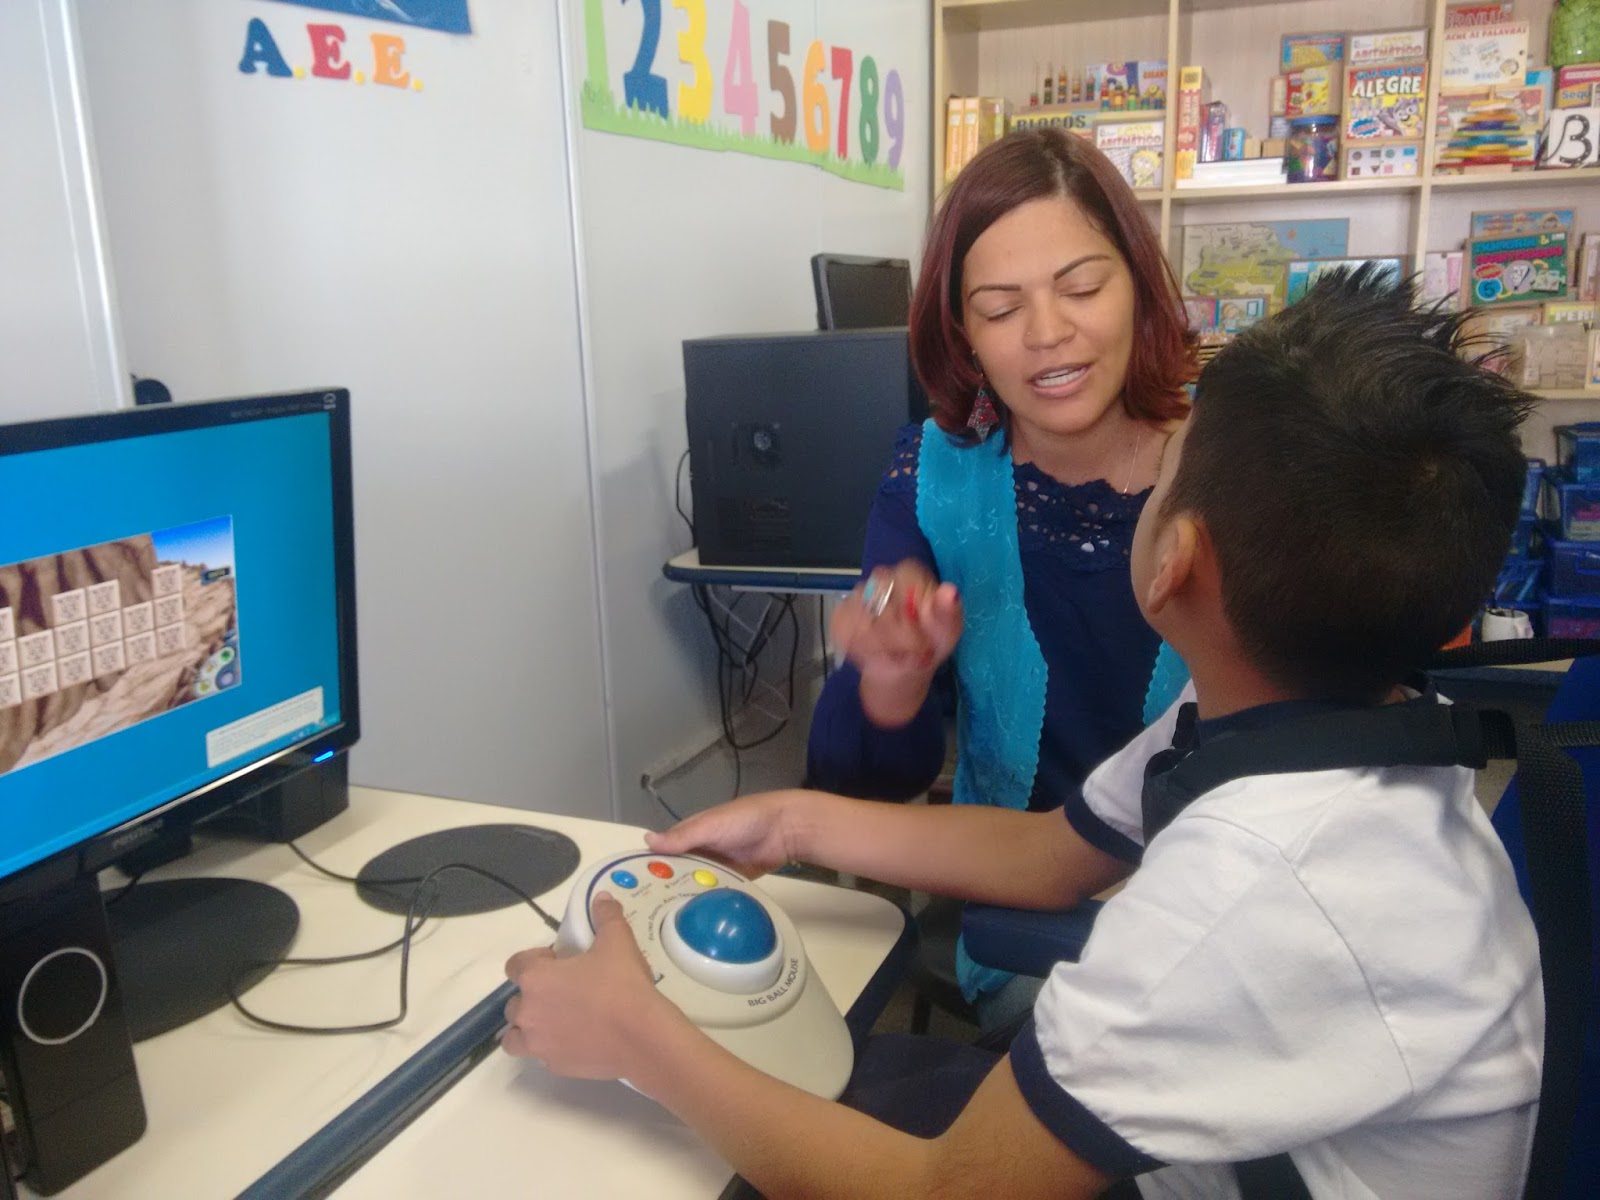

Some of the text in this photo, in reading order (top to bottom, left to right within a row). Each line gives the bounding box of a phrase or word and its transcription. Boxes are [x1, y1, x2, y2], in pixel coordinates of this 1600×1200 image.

[238, 17, 424, 92] A.E.E.
[1482, 26, 1527, 38] PALAVRAS
[621, 0, 669, 121] 2
[671, 0, 714, 126] 3
[723, 0, 758, 138] 4
[767, 19, 797, 146] 5
[803, 40, 831, 154] 6
[831, 46, 853, 160] 7
[859, 55, 880, 167] 8
[884, 69, 905, 172] 9
[1351, 75, 1422, 98] ALEGRE
[747, 957, 799, 1007] BIG BALL MOUSE
